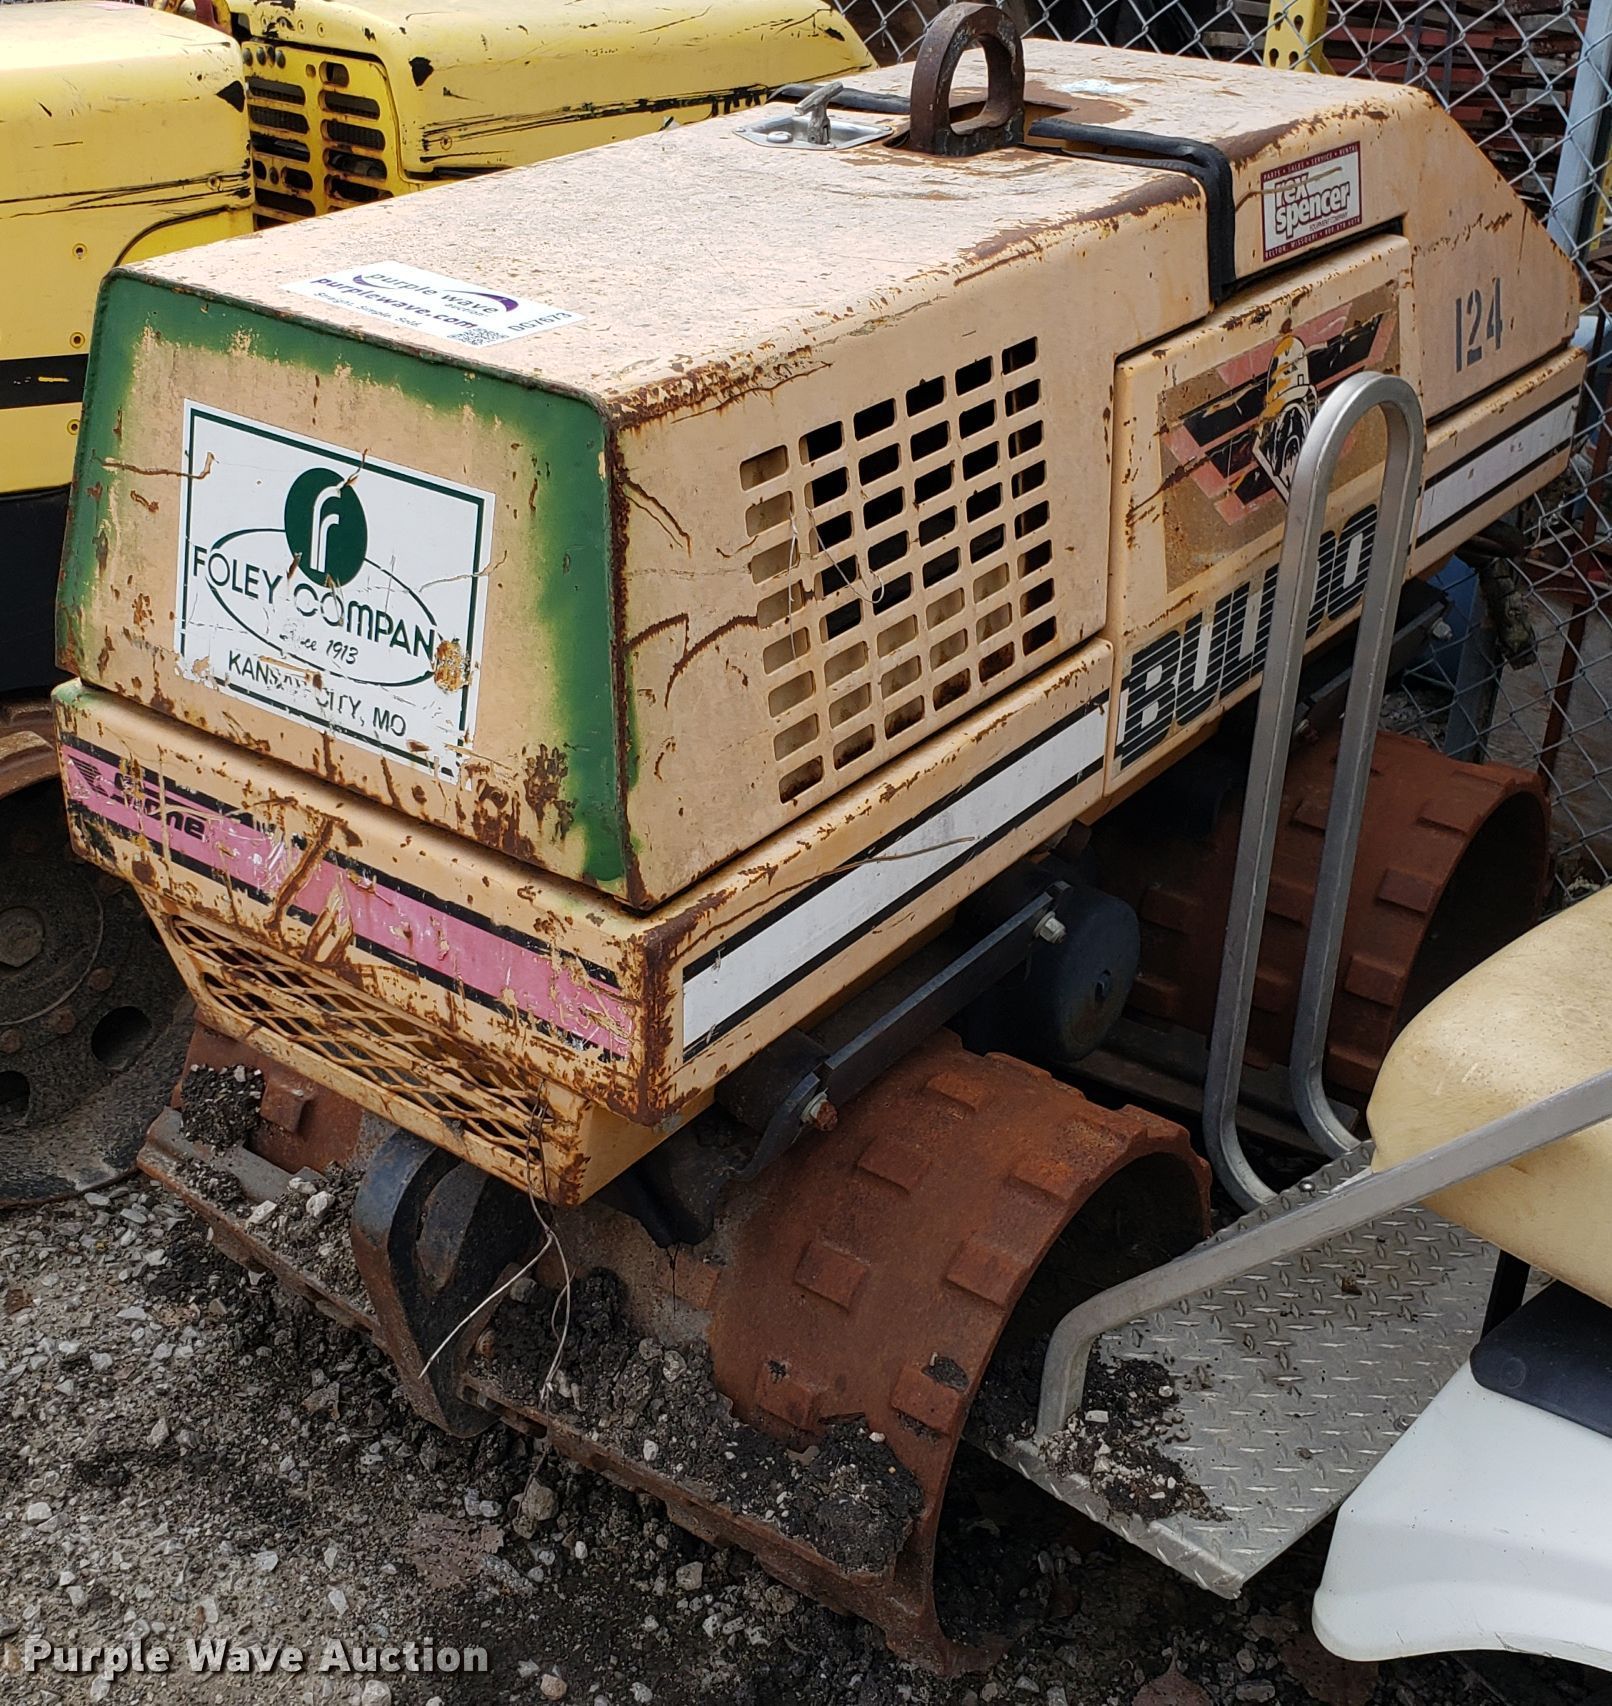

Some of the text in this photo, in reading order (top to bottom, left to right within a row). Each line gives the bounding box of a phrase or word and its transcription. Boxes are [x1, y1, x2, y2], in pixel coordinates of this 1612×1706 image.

[1274, 172, 1309, 207] rex
[1275, 181, 1350, 239] spencer
[310, 278, 478, 329] purplewave.com
[364, 273, 499, 313] purple wave
[1455, 277, 1504, 374] 124
[193, 545, 283, 604] FOLEY
[293, 582, 460, 666] COMPAN
[326, 639, 359, 665] 1913
[373, 709, 407, 738] MO
